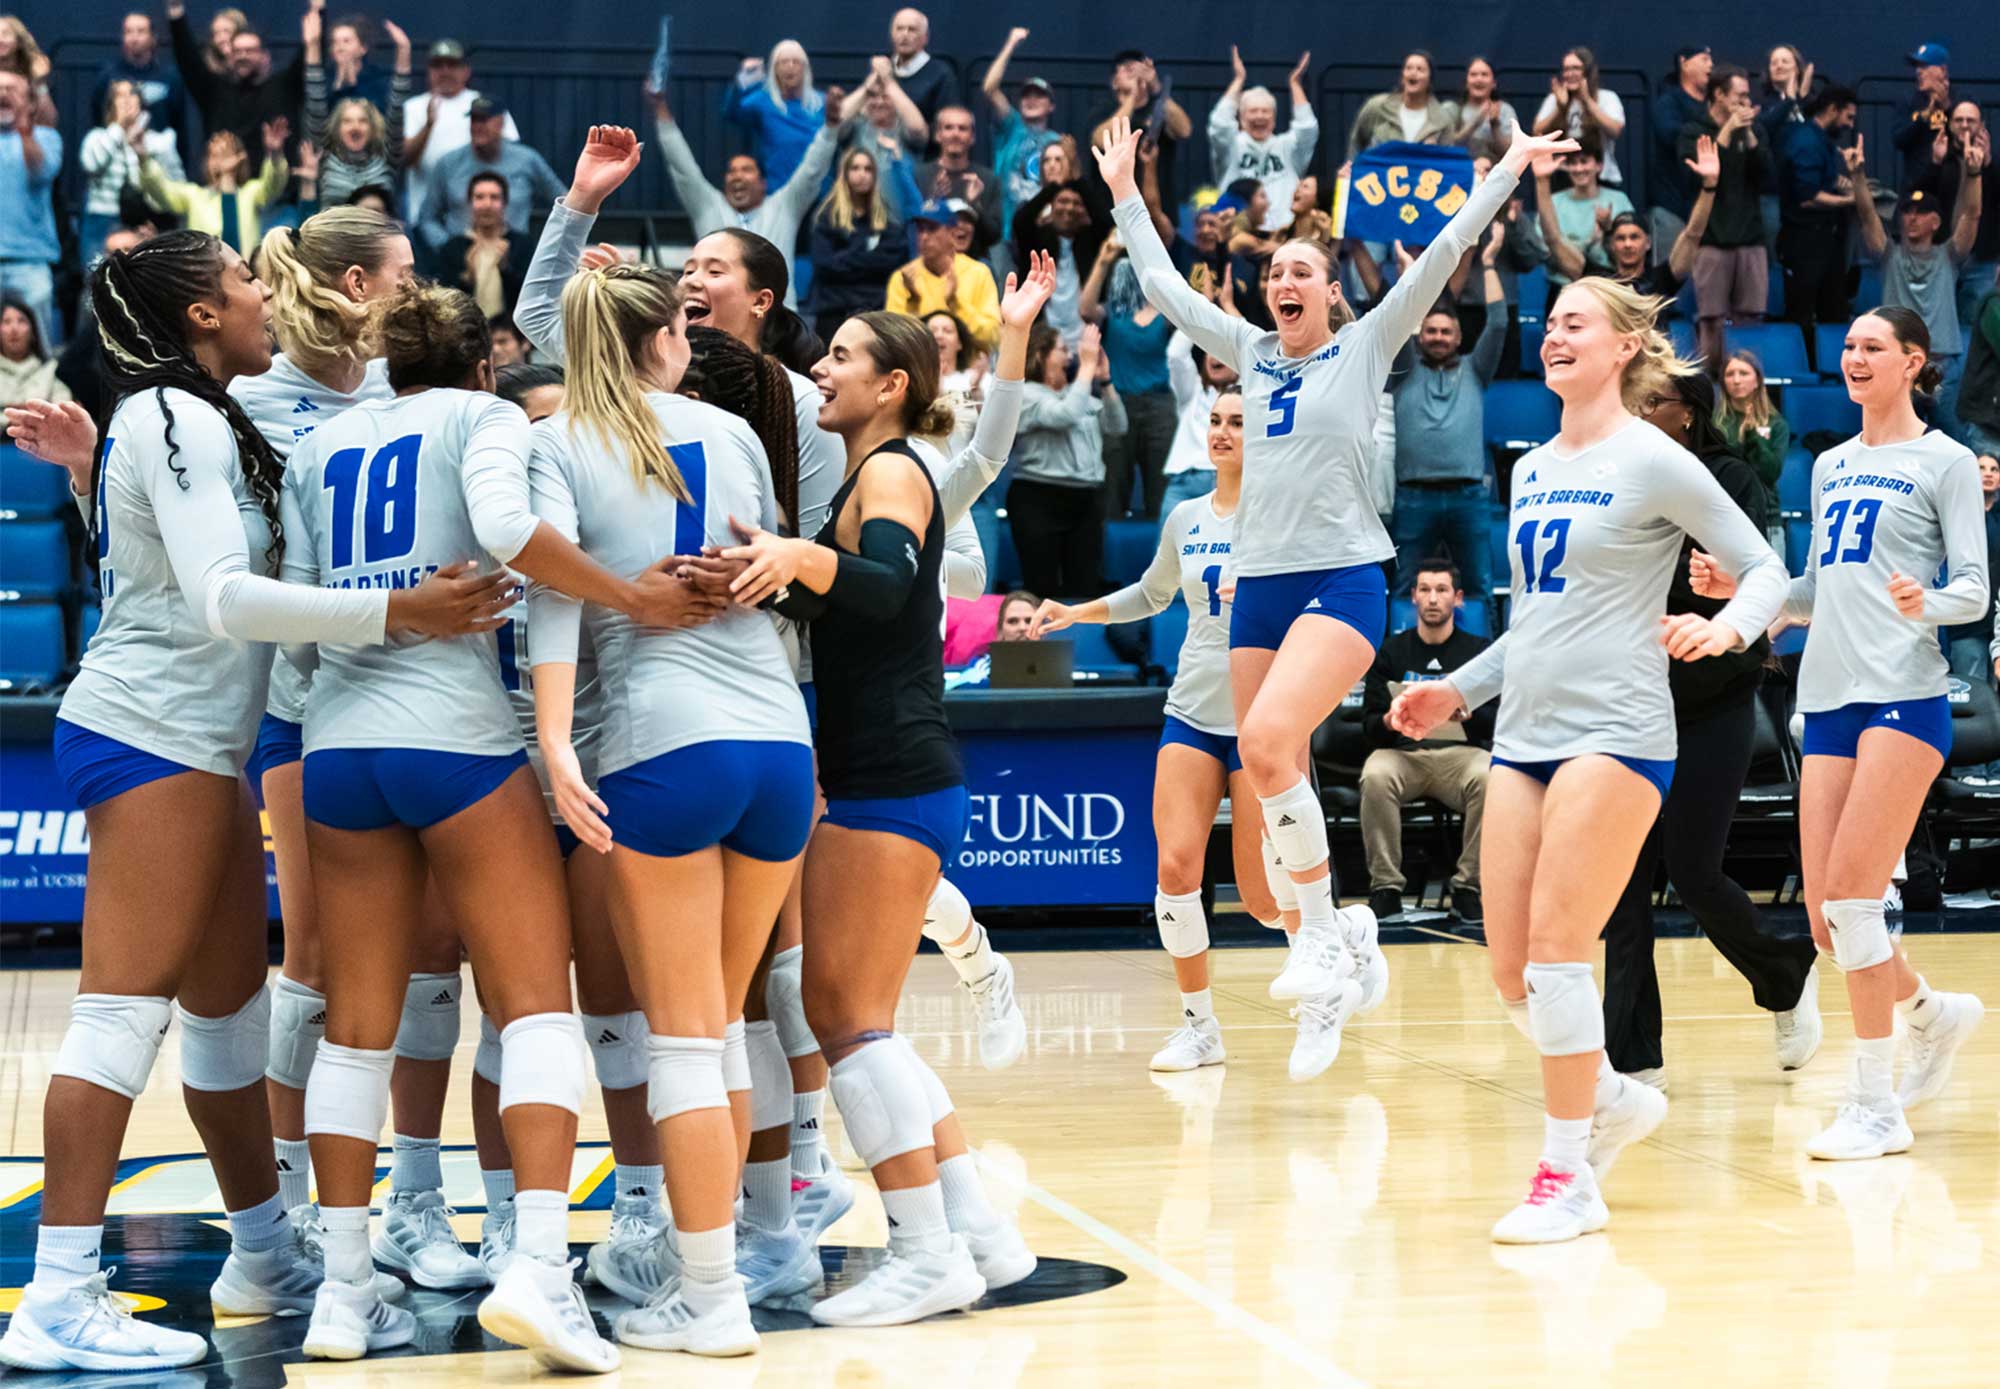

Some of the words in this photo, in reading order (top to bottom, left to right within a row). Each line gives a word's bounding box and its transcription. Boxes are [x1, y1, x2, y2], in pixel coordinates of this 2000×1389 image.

[1354, 165, 1468, 217] UCSB
[1266, 376, 1303, 438] 5
[323, 433, 424, 570] 18
[1546, 489, 1615, 508] BARBARA
[1853, 474, 1916, 496] BARBARA
[1515, 518, 1572, 594] 12
[1820, 498, 1884, 569] 33
[326, 562, 440, 591] ARTINE
[1202, 565, 1222, 616] 1
[963, 793, 1125, 843] FUND
[959, 848, 1122, 867] OPPORTUNITIES
